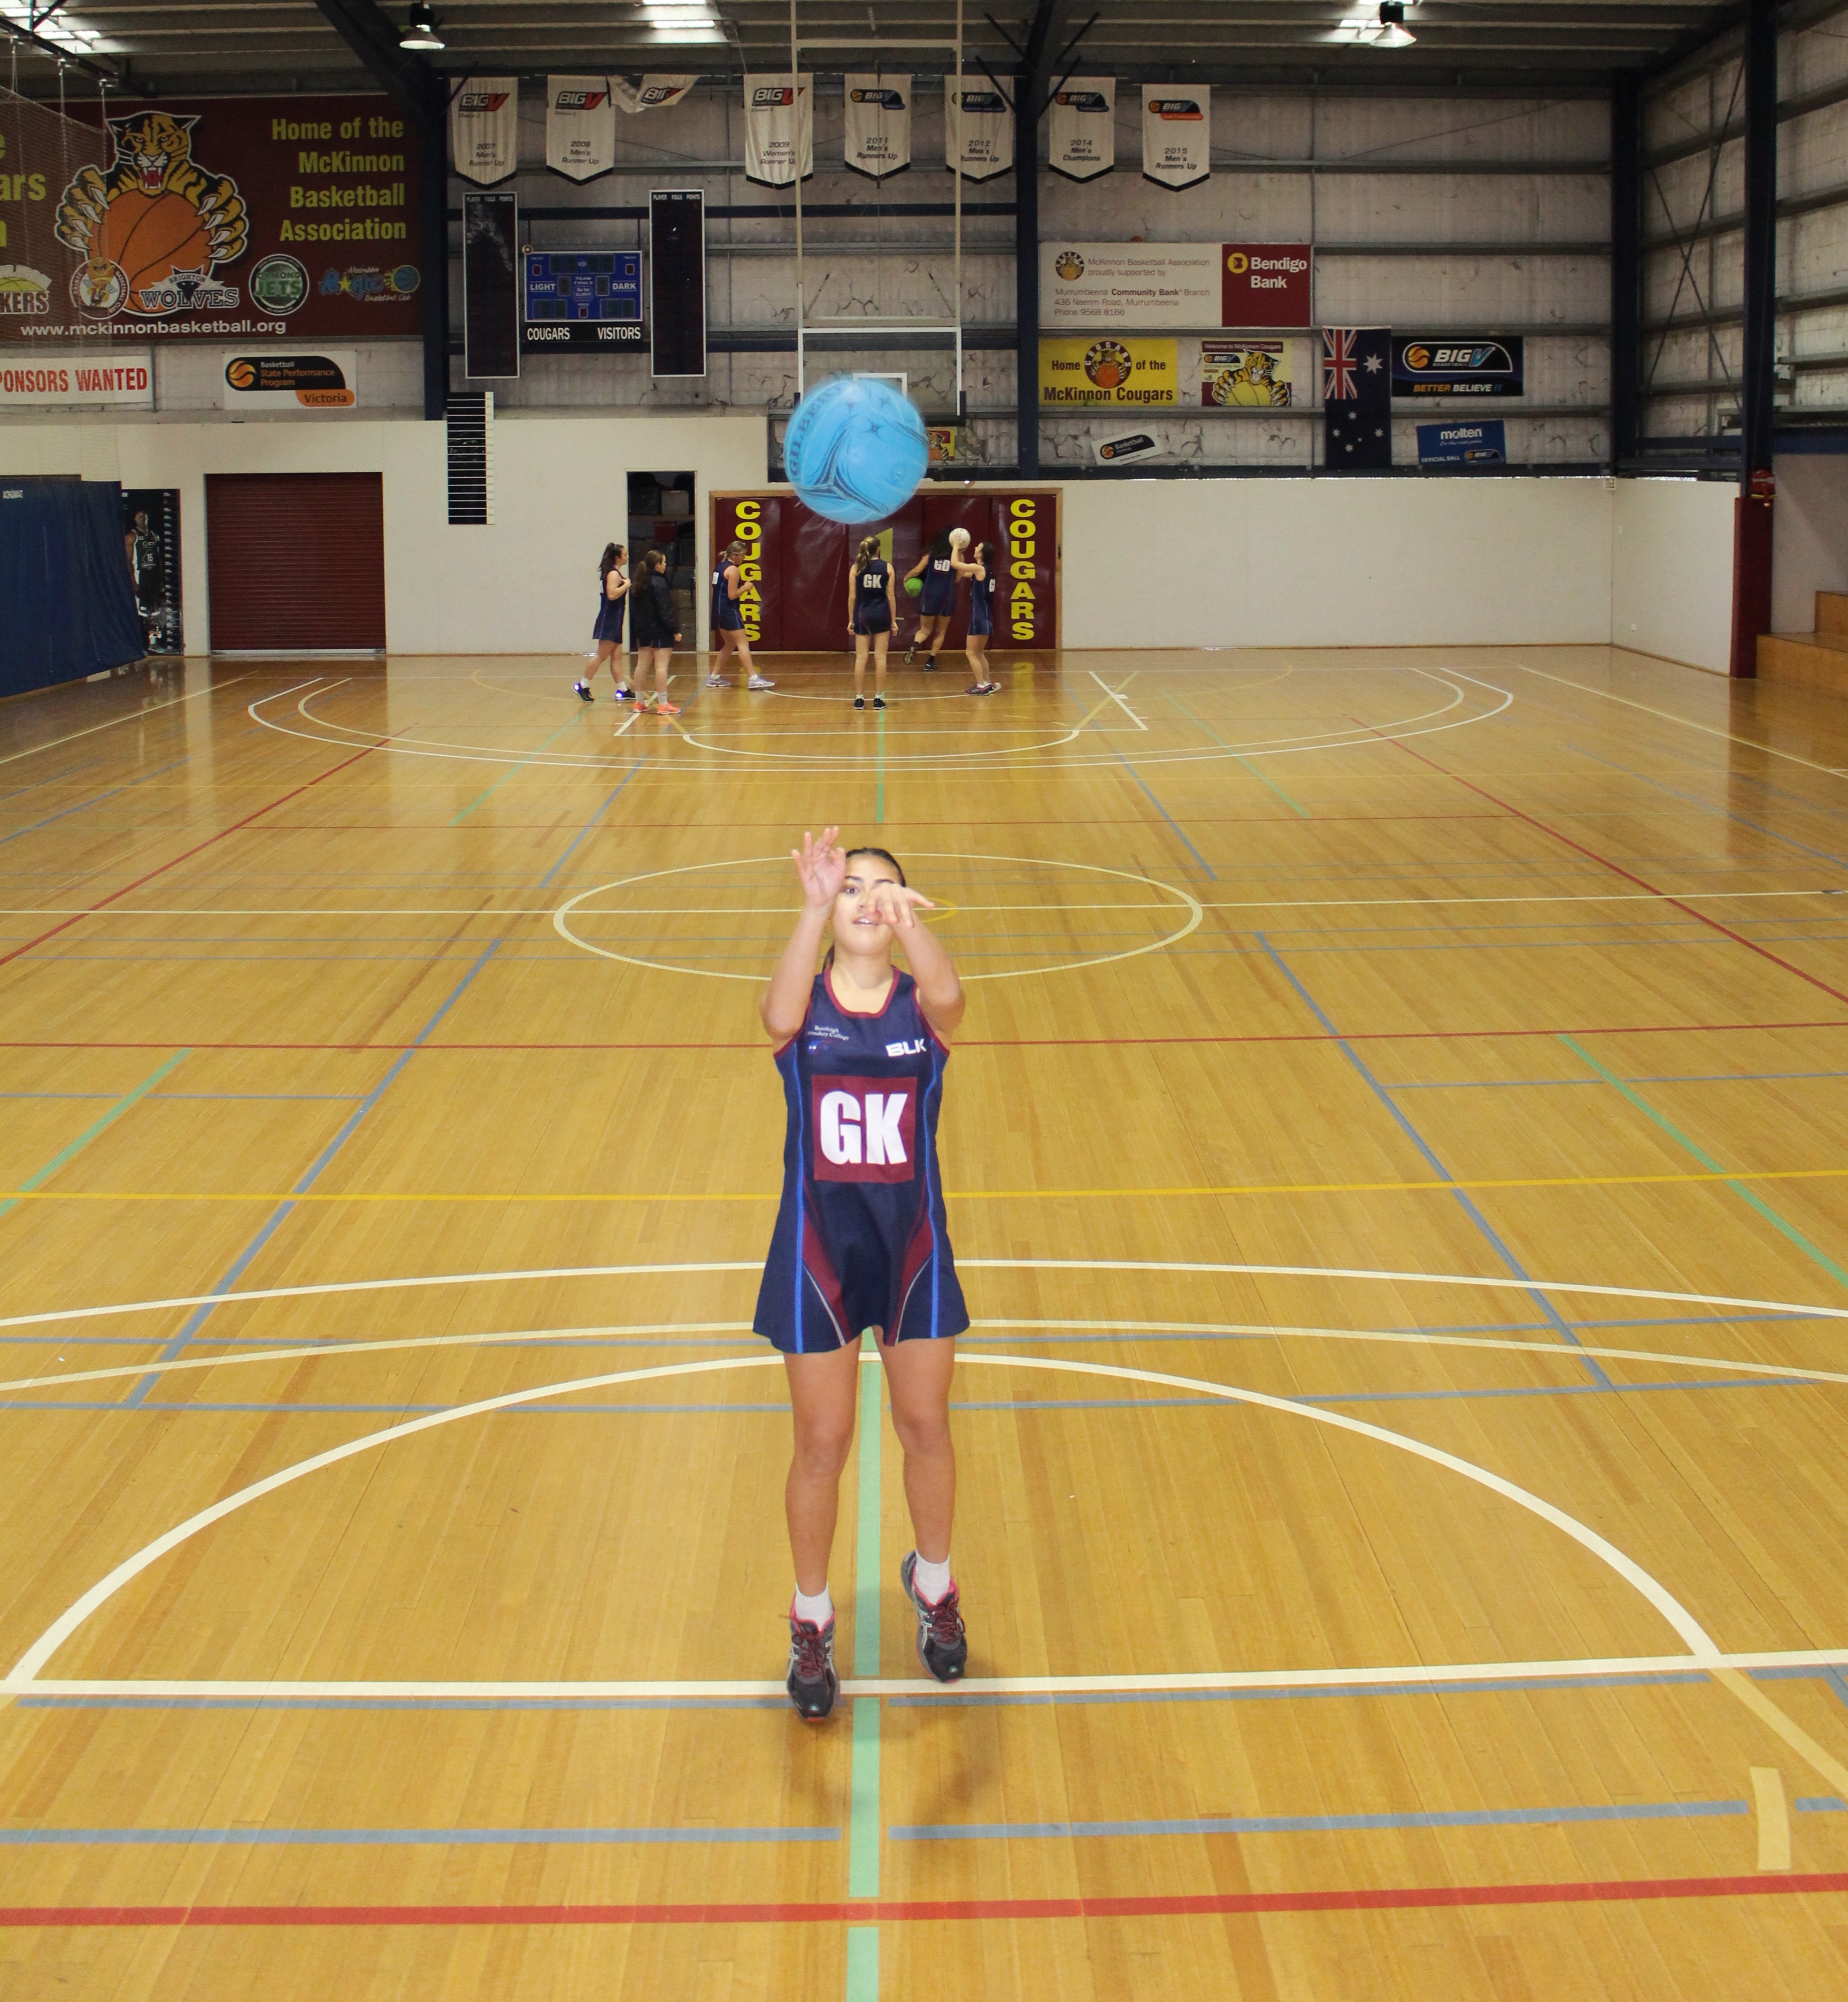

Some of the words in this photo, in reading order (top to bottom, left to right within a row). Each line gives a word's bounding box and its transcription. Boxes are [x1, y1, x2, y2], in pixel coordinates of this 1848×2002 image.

[272, 118, 332, 140] Home
[340, 117, 361, 139] of
[368, 117, 404, 138] the
[299, 151, 404, 173] McKinnon
[290, 183, 405, 208] Basketball
[280, 218, 406, 241] Association
[1251, 257, 1308, 273] Bendigo
[170, 272, 206, 283] BRIGHTON
[1158, 269, 1166, 278] by
[254, 279, 303, 297] JETS
[1251, 275, 1288, 288] Bank
[140, 288, 240, 309] WOLVES
[1112, 289, 1157, 297] Community
[20, 320, 286, 336] www.mckinnonbasketball.org
[527, 327, 571, 341] COUGARS
[597, 327, 641, 340] VISITORS
[1085, 341, 1132, 367] COUGARS
[1052, 360, 1081, 371] Home
[1136, 360, 1146, 370] of
[1150, 360, 1166, 370] the
[0, 369, 68, 392] ONSORS
[75, 368, 147, 392] WANTED
[260, 379, 295, 387] Program
[1044, 387, 1111, 401] McKinnon
[1116, 387, 1173, 403] Cougars
[1413, 384, 1451, 392] BETTER
[1452, 384, 1492, 392] BELIEVE
[304, 394, 347, 404] Victoria
[1441, 428, 1483, 440] molten
[1114, 437, 1144, 450] Basketball
[934, 559, 951, 572] GD
[1010, 499, 1036, 640] COUGARS
[863, 573, 882, 588] GK
[814, 1025, 839, 1033] Bentleigh
[829, 1032, 849, 1041] College
[885, 1039, 927, 1057] BLK
[820, 1090, 908, 1165] GK
